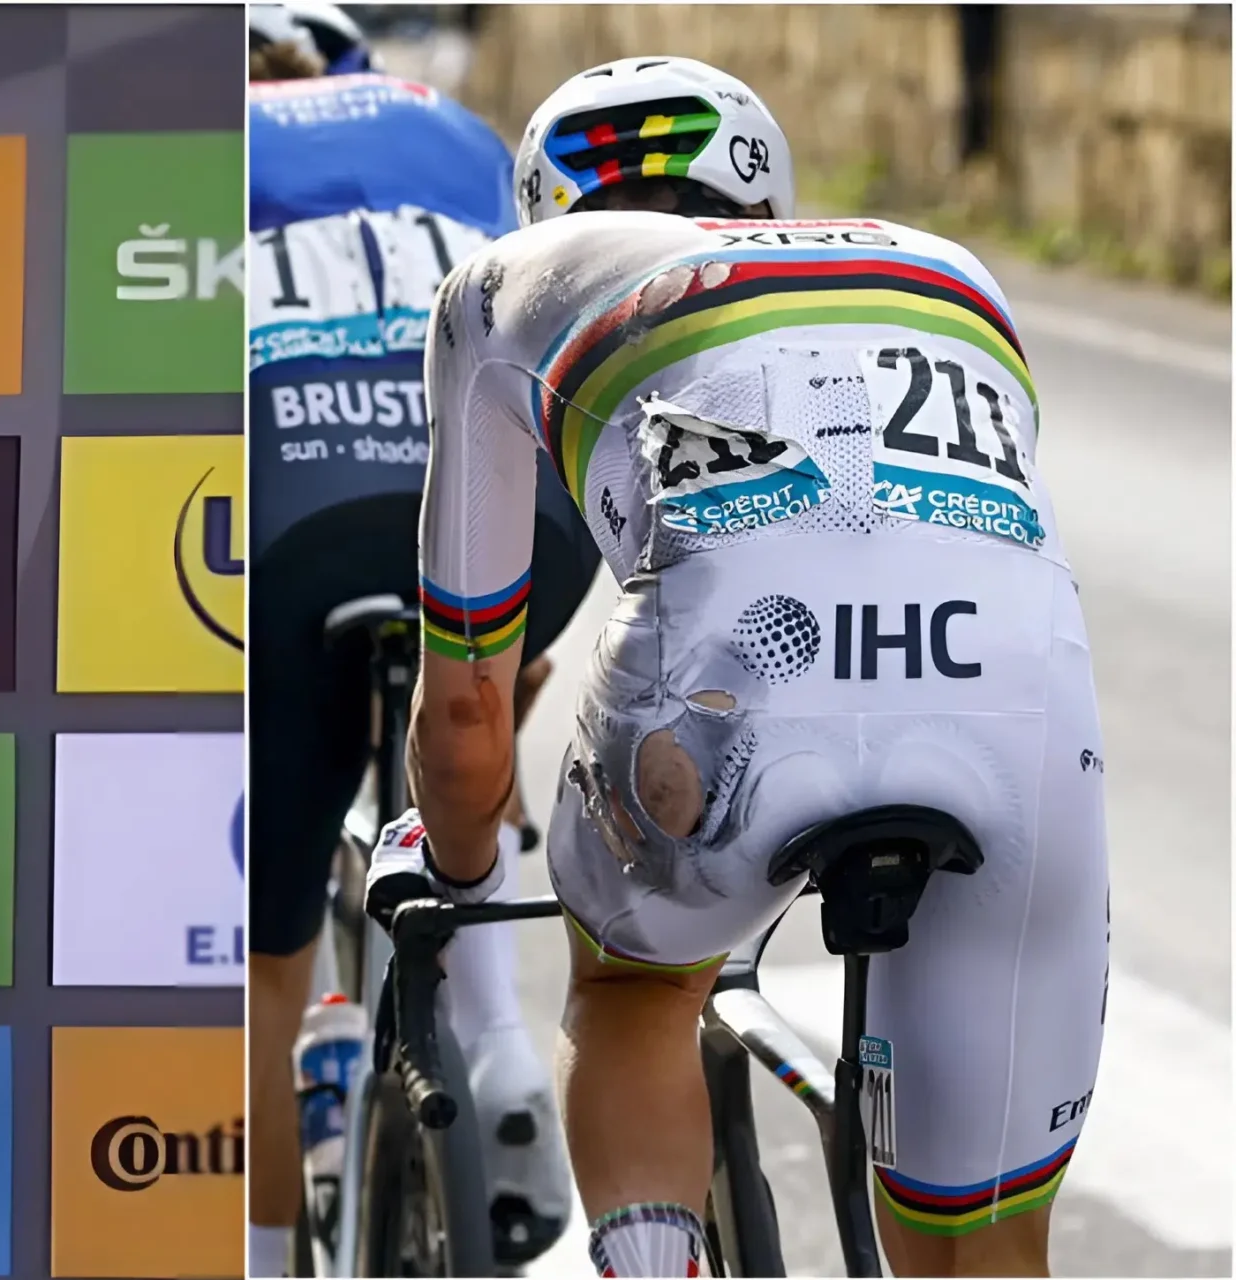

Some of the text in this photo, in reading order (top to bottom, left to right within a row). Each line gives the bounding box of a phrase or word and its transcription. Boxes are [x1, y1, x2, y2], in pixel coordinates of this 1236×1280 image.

[876, 345, 1031, 492] 211
[928, 489, 1020, 521] CRÉDIT
[833, 600, 983, 681] IHC
